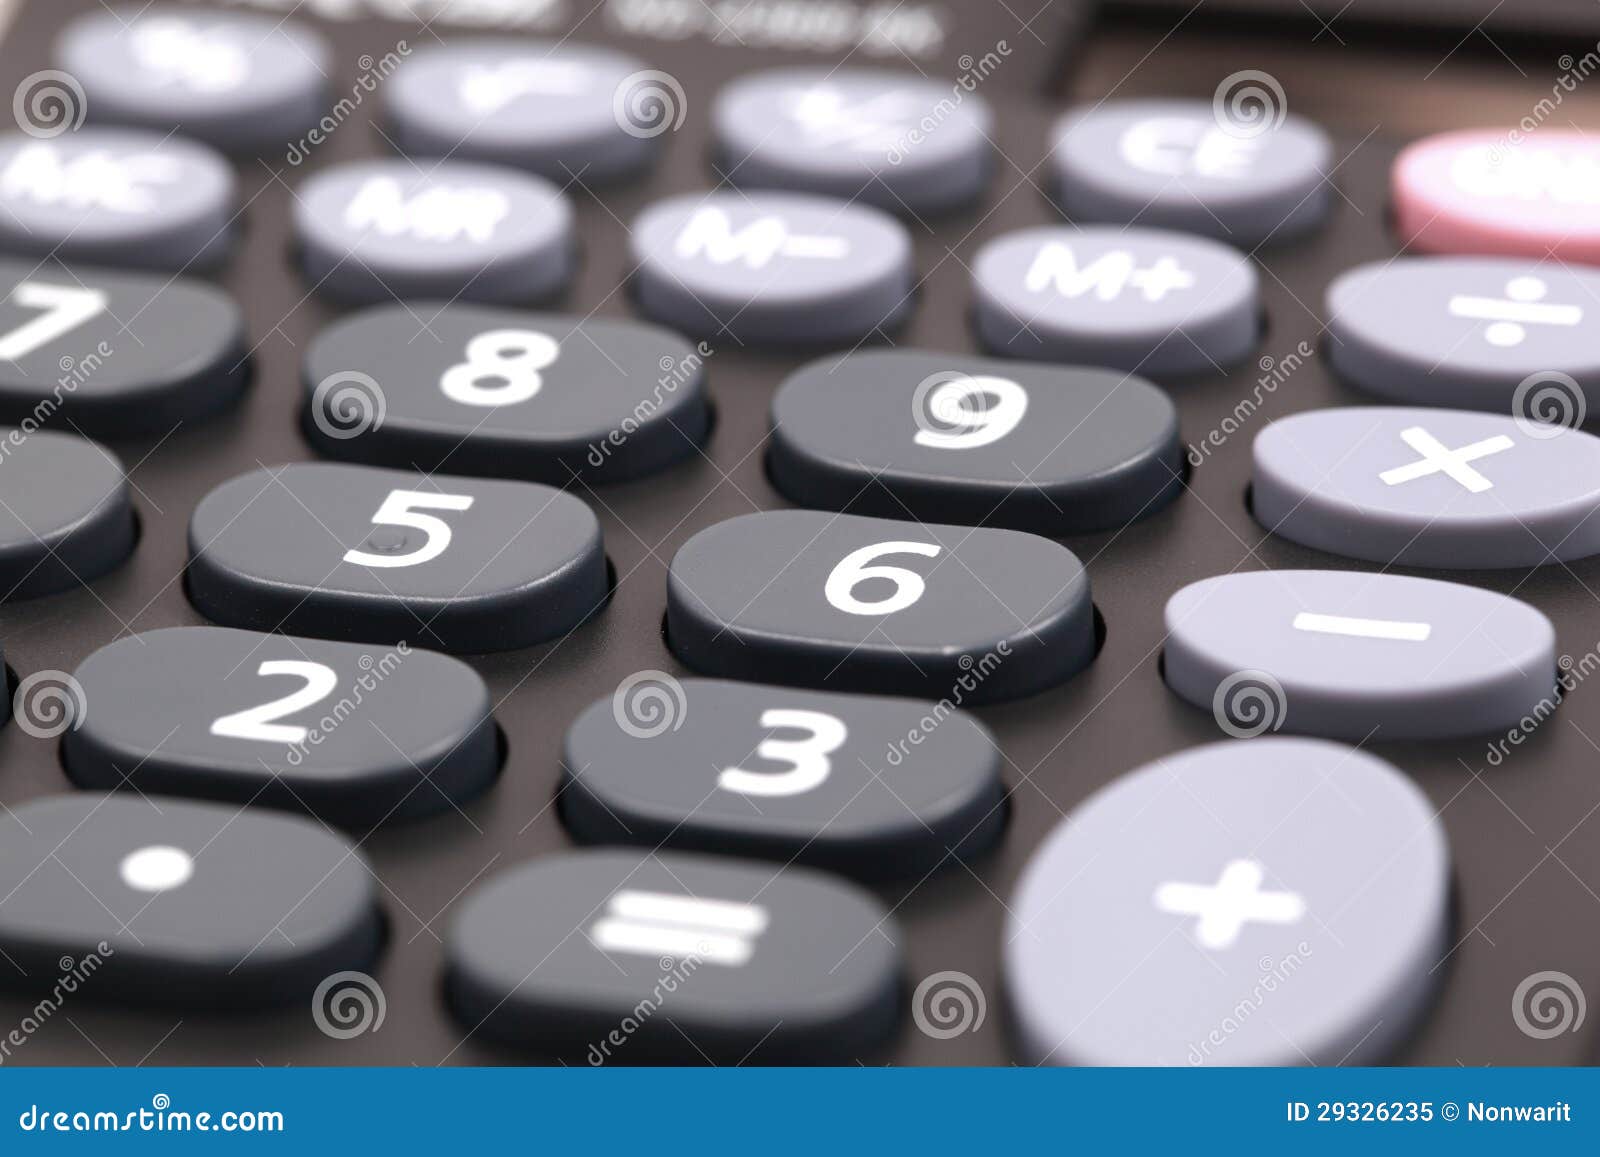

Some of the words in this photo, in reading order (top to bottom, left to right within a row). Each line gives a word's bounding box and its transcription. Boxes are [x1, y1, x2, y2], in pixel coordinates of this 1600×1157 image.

[1024, 241, 1196, 302] M+
[0, 283, 107, 361] 7
[439, 328, 560, 407] 8
[913, 375, 1029, 450] 9
[342, 489, 475, 568] 5
[824, 541, 942, 616] 6
[210, 660, 339, 744] 2
[718, 709, 848, 797] 3
